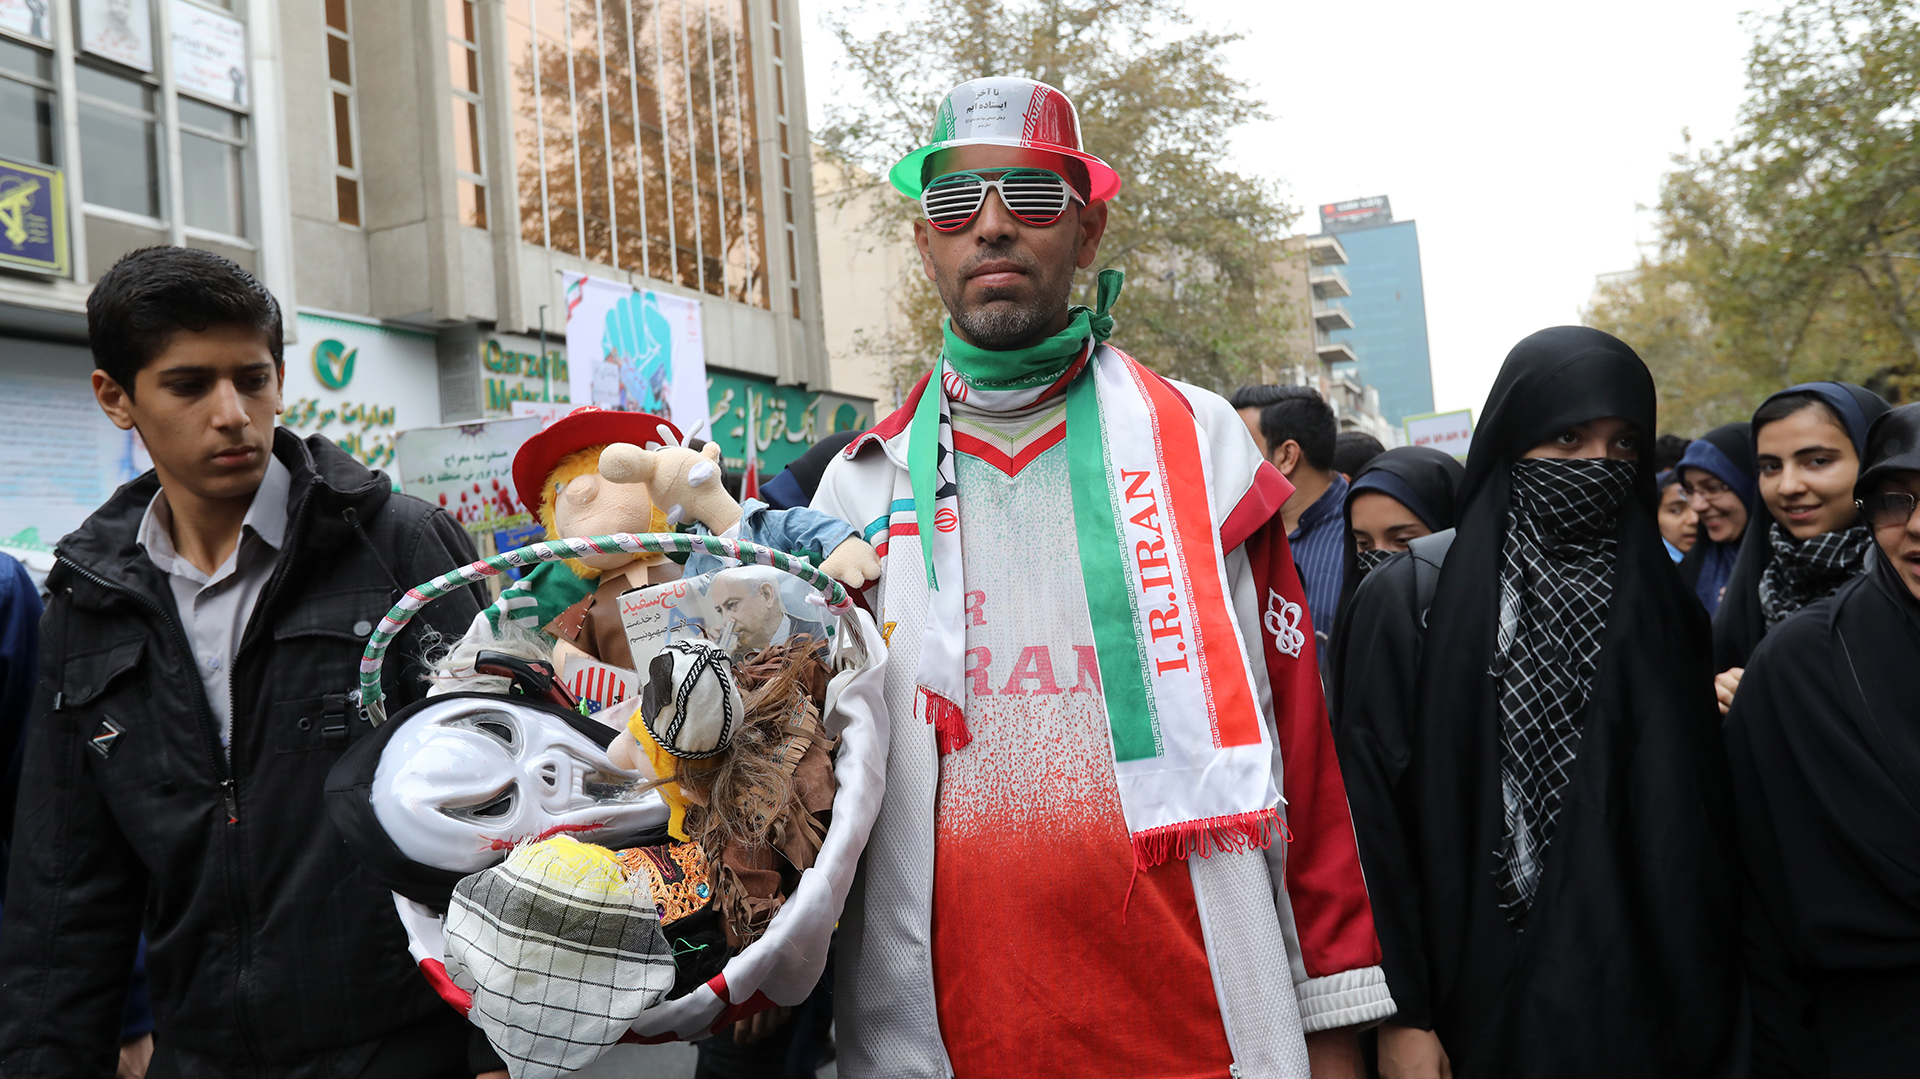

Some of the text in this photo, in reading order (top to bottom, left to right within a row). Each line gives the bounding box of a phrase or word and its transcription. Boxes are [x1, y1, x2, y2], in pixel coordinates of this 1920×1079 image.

[975, 87, 991, 100] آخر
[979, 101, 1007, 111] ایستاده
[622, 581, 687, 616] کاخ سفید
[625, 613, 662, 628] در خدمت
